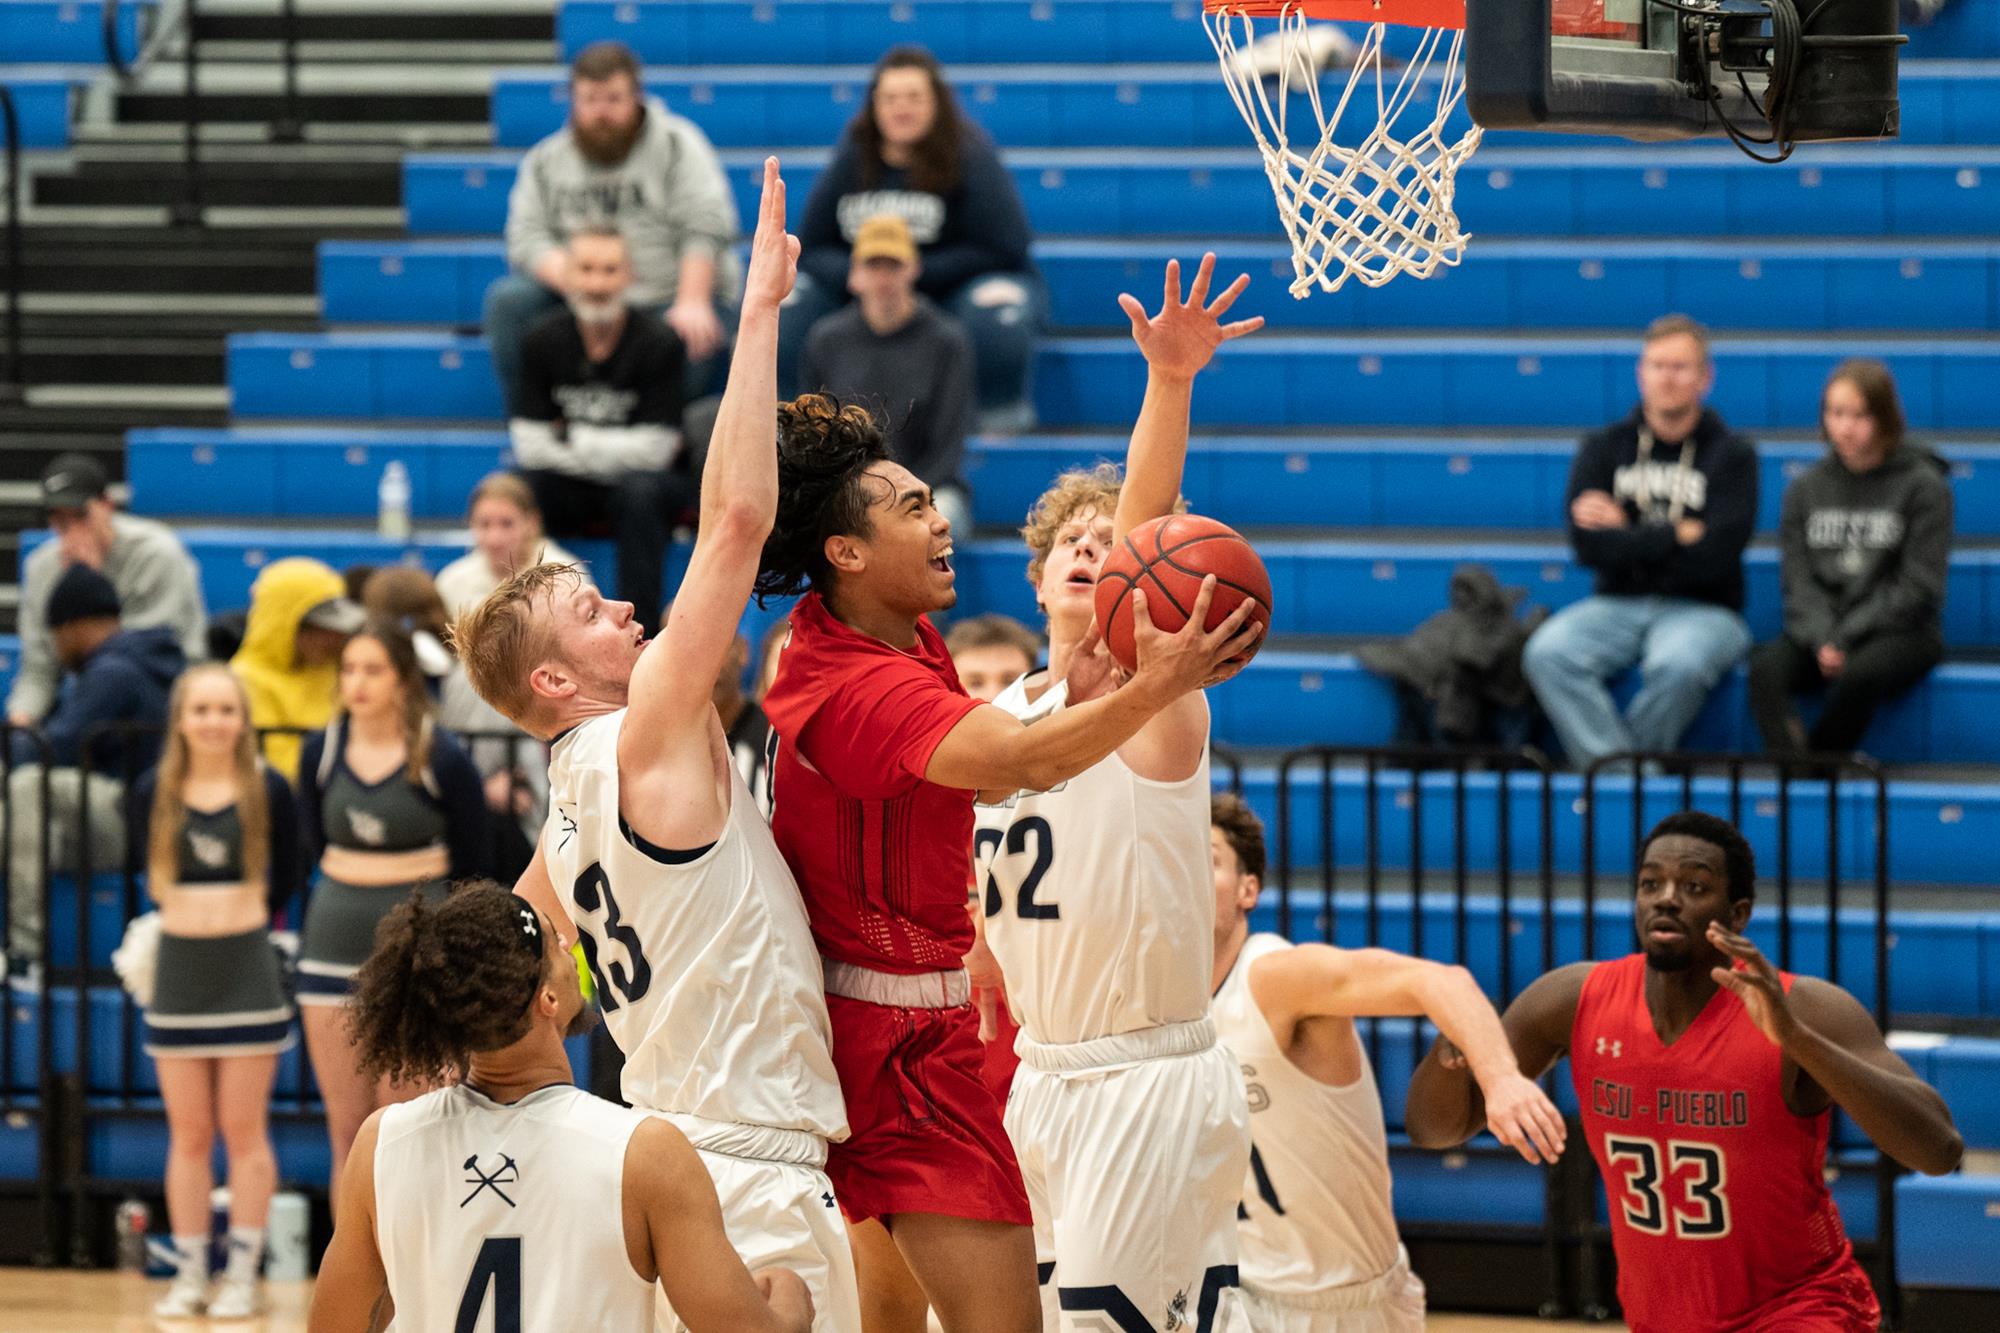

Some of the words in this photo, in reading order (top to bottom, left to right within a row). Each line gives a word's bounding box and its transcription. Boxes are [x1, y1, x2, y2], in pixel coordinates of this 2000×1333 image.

[1593, 1079, 1632, 1120] CSU
[1657, 1088, 1748, 1127] PUEBLO
[1604, 1132, 1732, 1239] 33
